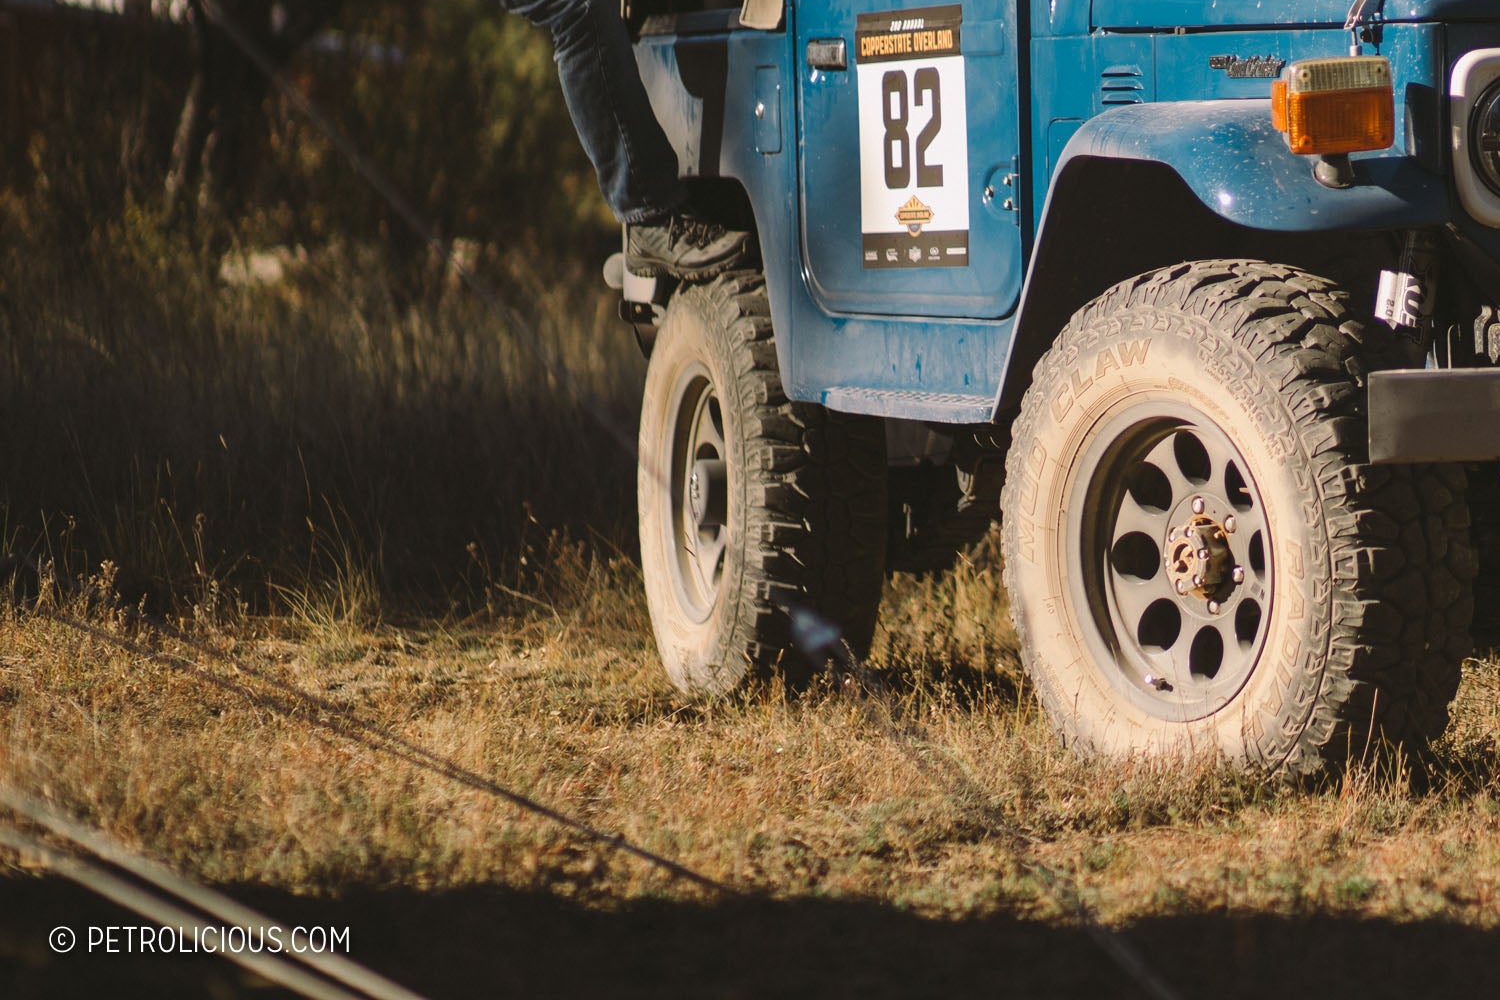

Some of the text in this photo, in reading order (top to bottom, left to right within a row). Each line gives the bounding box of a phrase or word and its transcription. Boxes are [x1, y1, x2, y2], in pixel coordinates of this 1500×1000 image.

[861, 29, 953, 57] COPPERSTATE OVERLAND
[882, 67, 944, 189] 82
[1018, 338, 1152, 563] MUD CLAW
[1250, 538, 1305, 746] RADIAL
